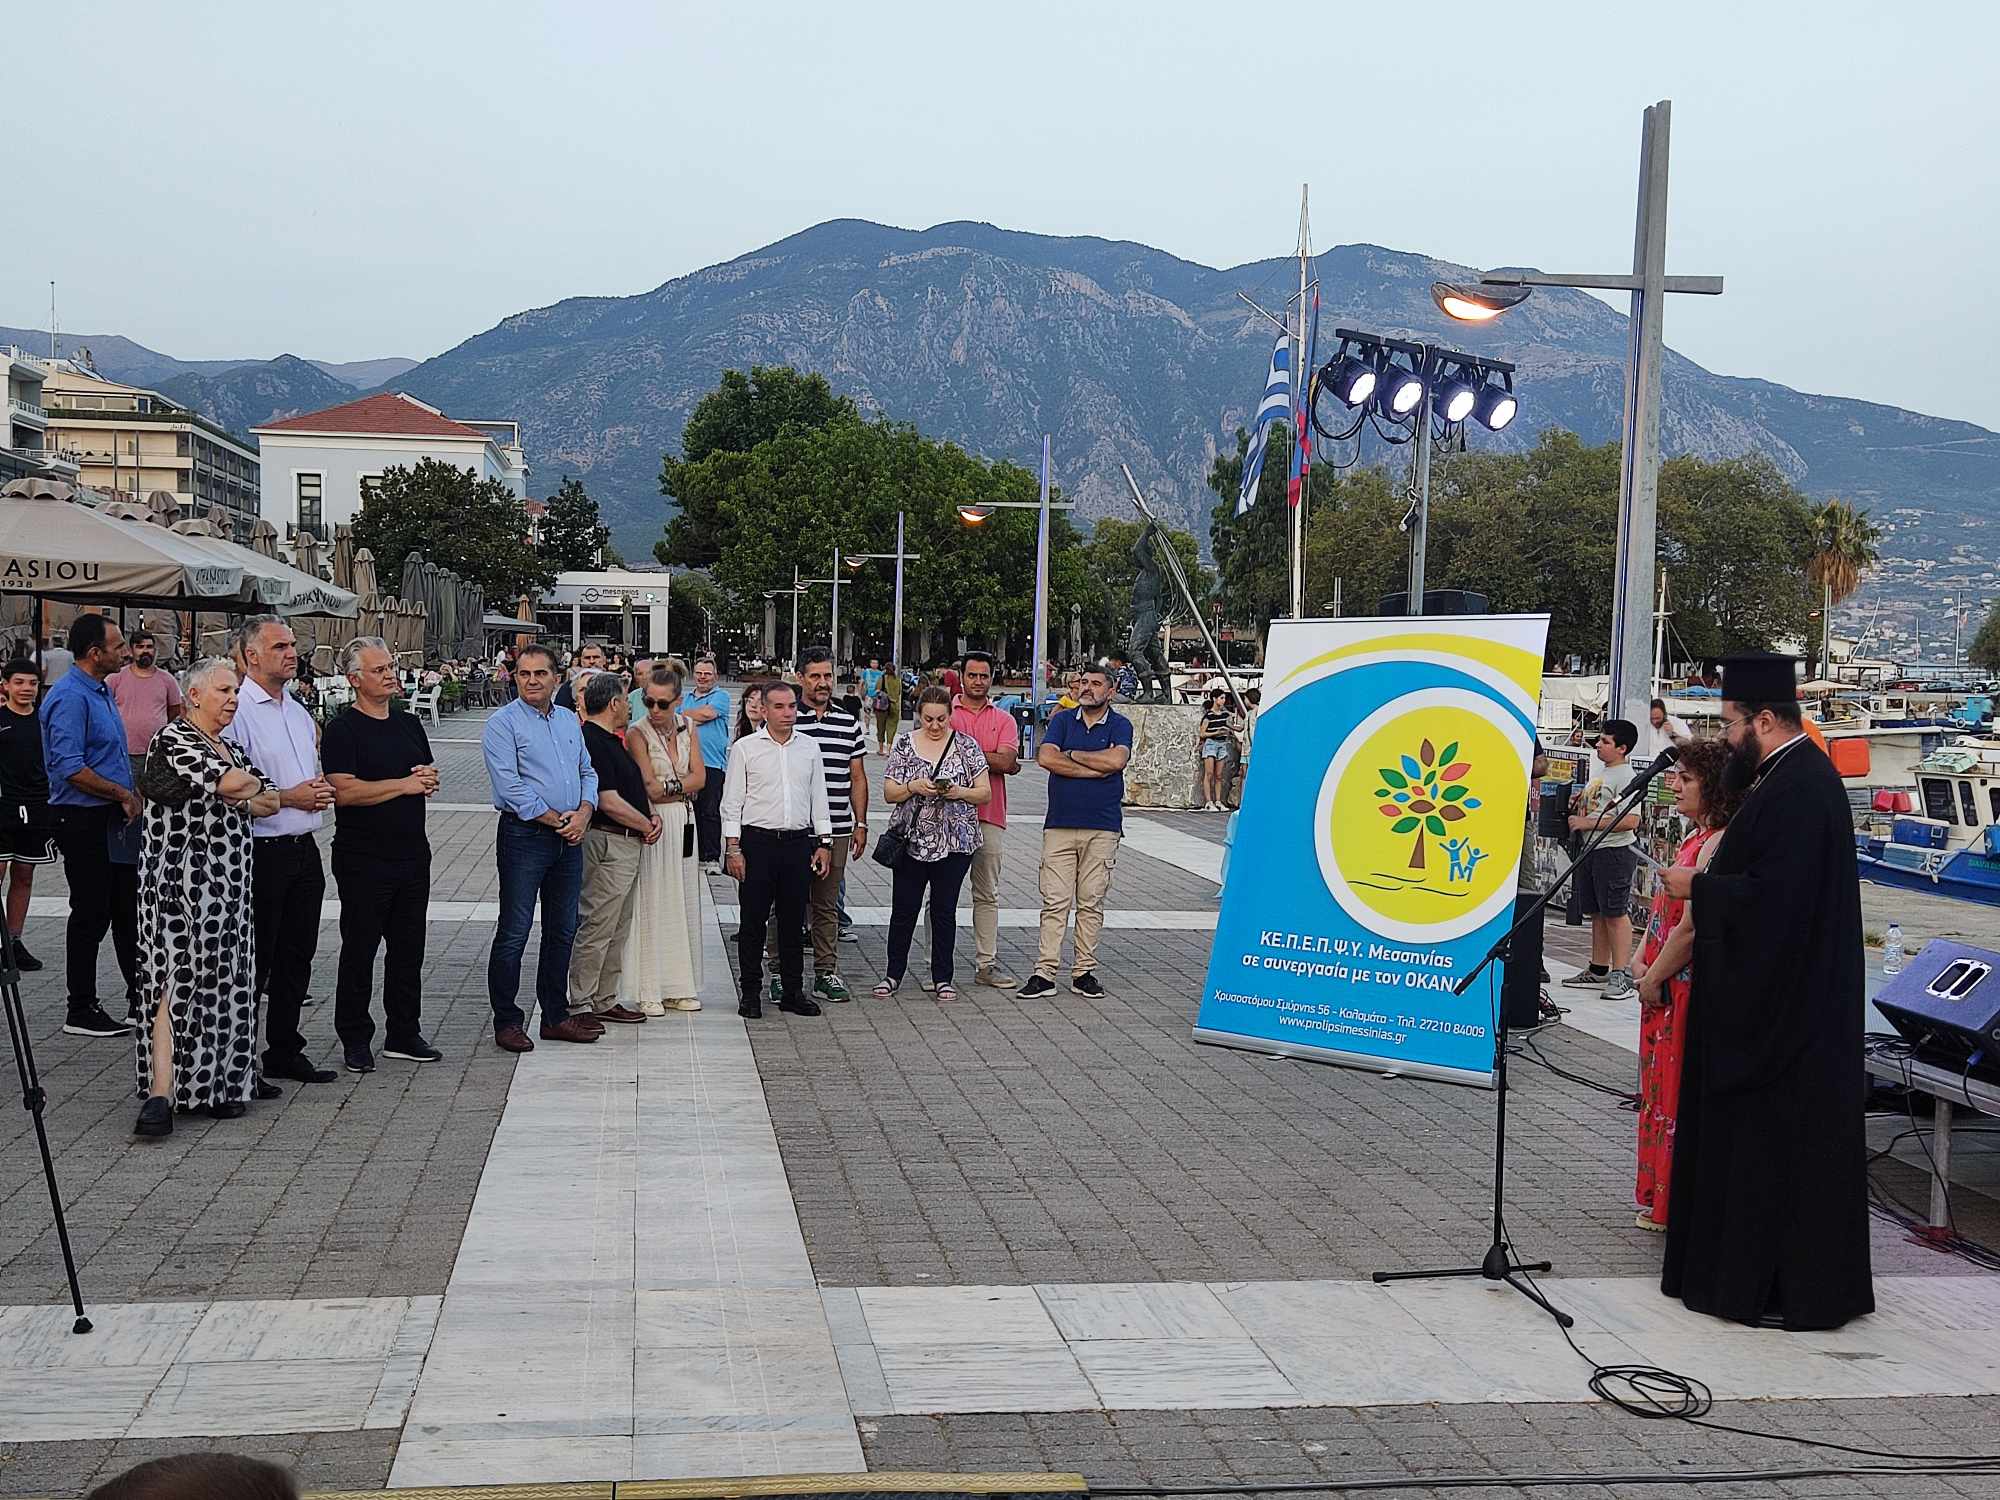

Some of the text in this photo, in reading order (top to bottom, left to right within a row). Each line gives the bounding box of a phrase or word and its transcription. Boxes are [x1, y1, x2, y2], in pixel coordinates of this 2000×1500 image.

[1242, 954, 1260, 967] σε
[1263, 957, 1349, 979] συνεργασία
[1351, 969, 1371, 984] με
[1375, 971, 1401, 986] τον
[1368, 943, 1453, 968] Μεσσηνίας
[1214, 989, 1274, 1008] Χρυσοστόμου
[1276, 998, 1316, 1014] Σμύρνης
[1318, 1004, 1330, 1016] 56
[1339, 1007, 1387, 1024] Καλαμάτα
[1397, 1015, 1417, 1029] Τηλ.
[1419, 1018, 1451, 1033] 27210
[1452, 1023, 1485, 1038] 84009
[1279, 1015, 1407, 1045] www.prolipsimessinias.gr
